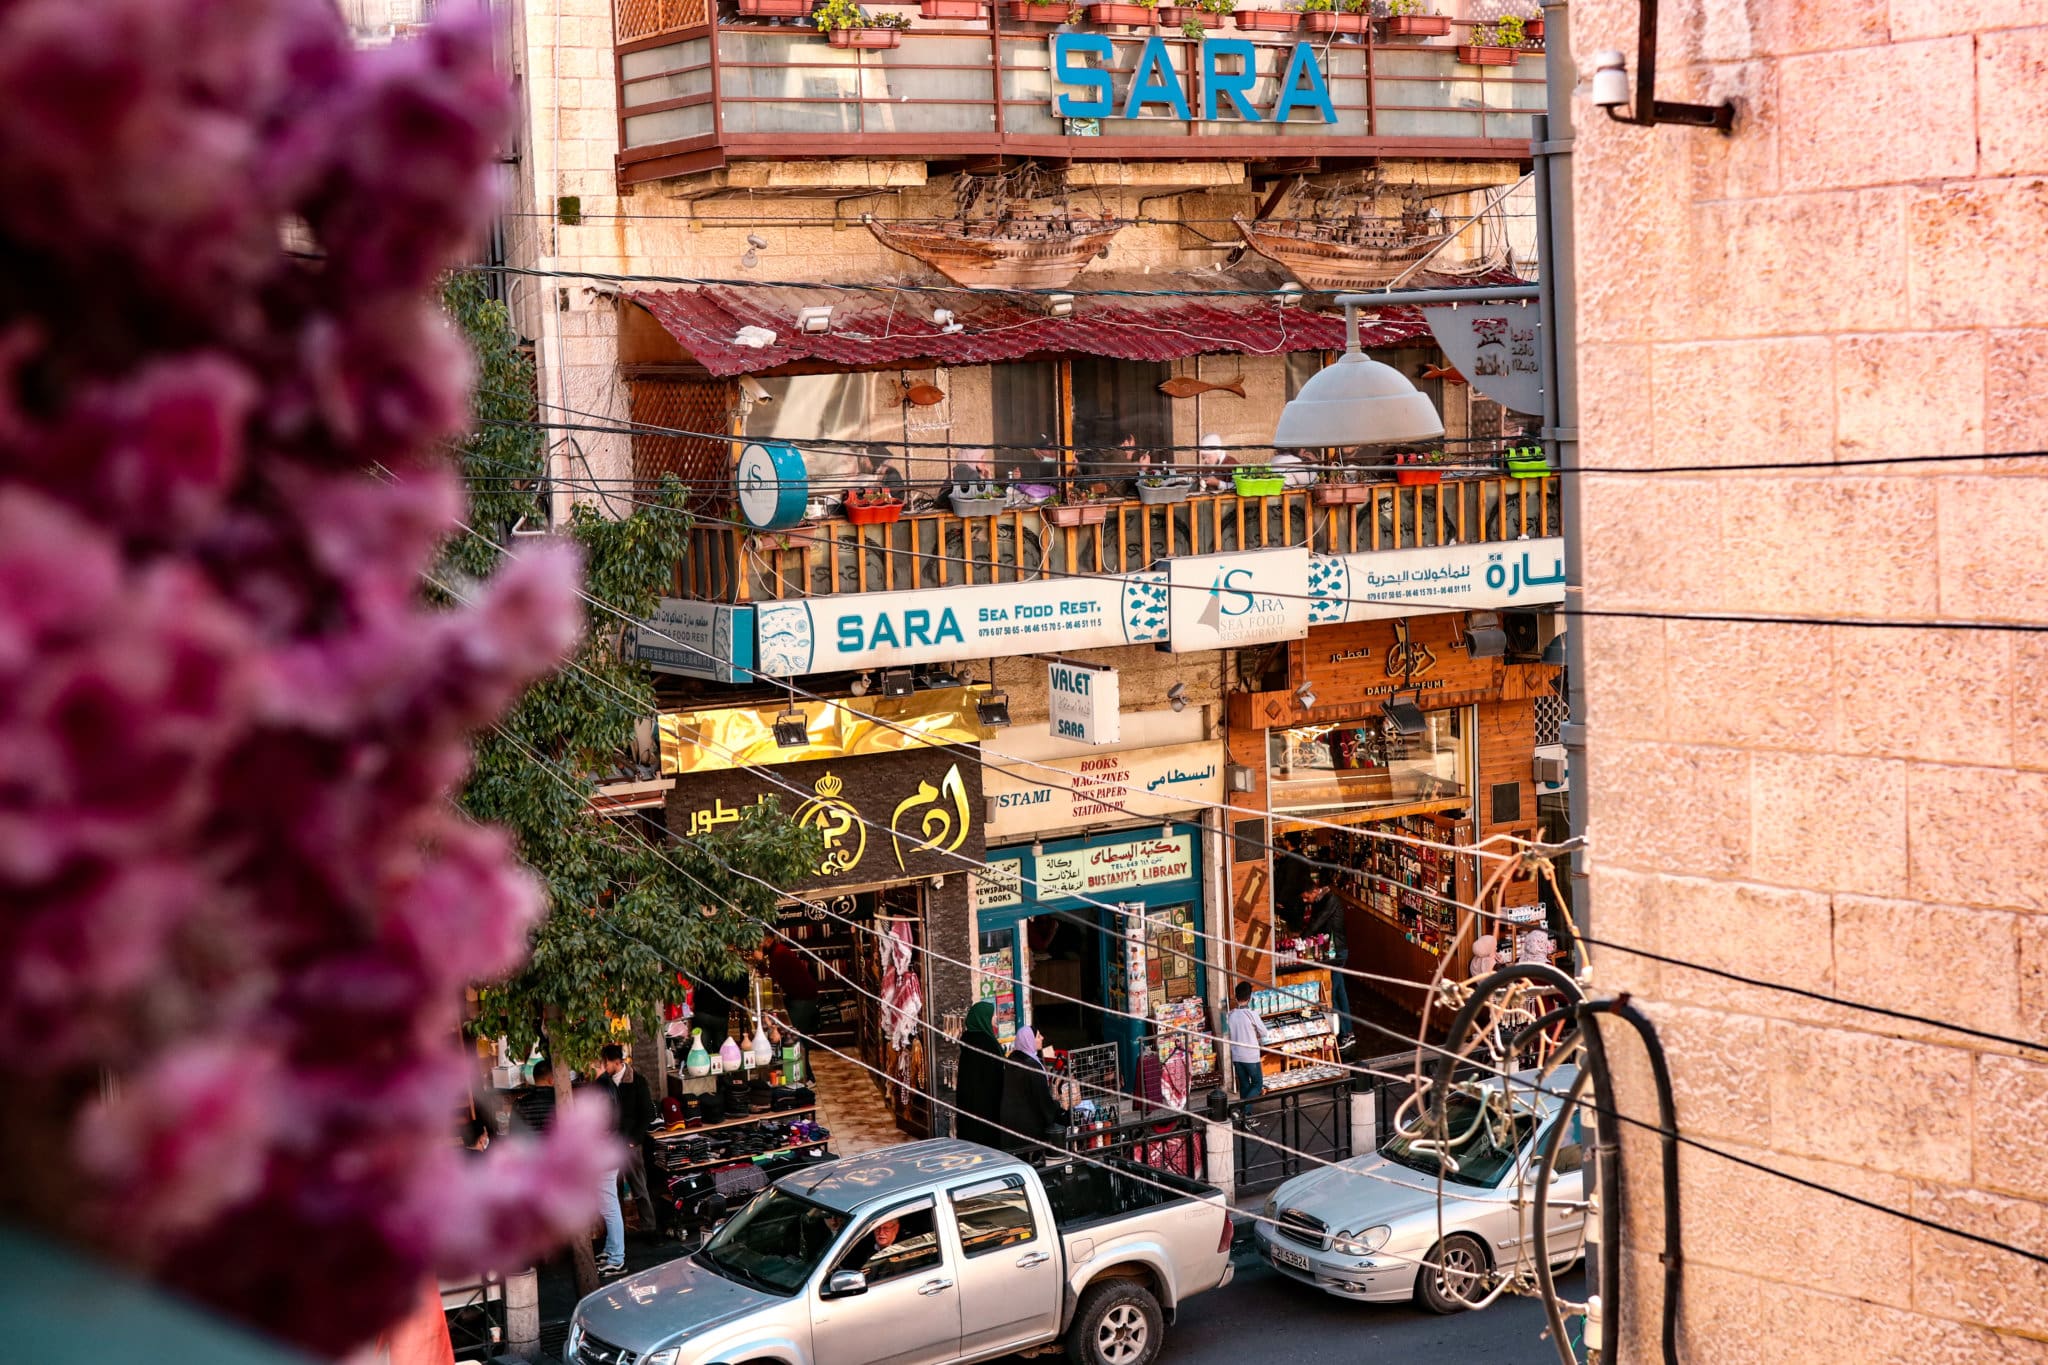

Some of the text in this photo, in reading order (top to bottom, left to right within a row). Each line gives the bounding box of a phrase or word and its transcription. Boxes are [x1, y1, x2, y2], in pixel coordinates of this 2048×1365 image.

[1056, 33, 1338, 123] SARA
[978, 608, 1009, 622] SEA
[1014, 604, 1053, 619] FOOD
[837, 607, 965, 653] SARA
[1220, 614, 1285, 632] SEA FOOD
[691, 632, 708, 643] REST
[1220, 627, 1284, 641] RESTAURANT
[1050, 666, 1091, 696] VALET
[1058, 718, 1085, 739] SARA
[1080, 757, 1118, 772] BOOKS
[1096, 786, 1127, 799] PAPERS
[1142, 862, 1187, 880] LIBRARY
[988, 894, 1011, 904] BOOKS
